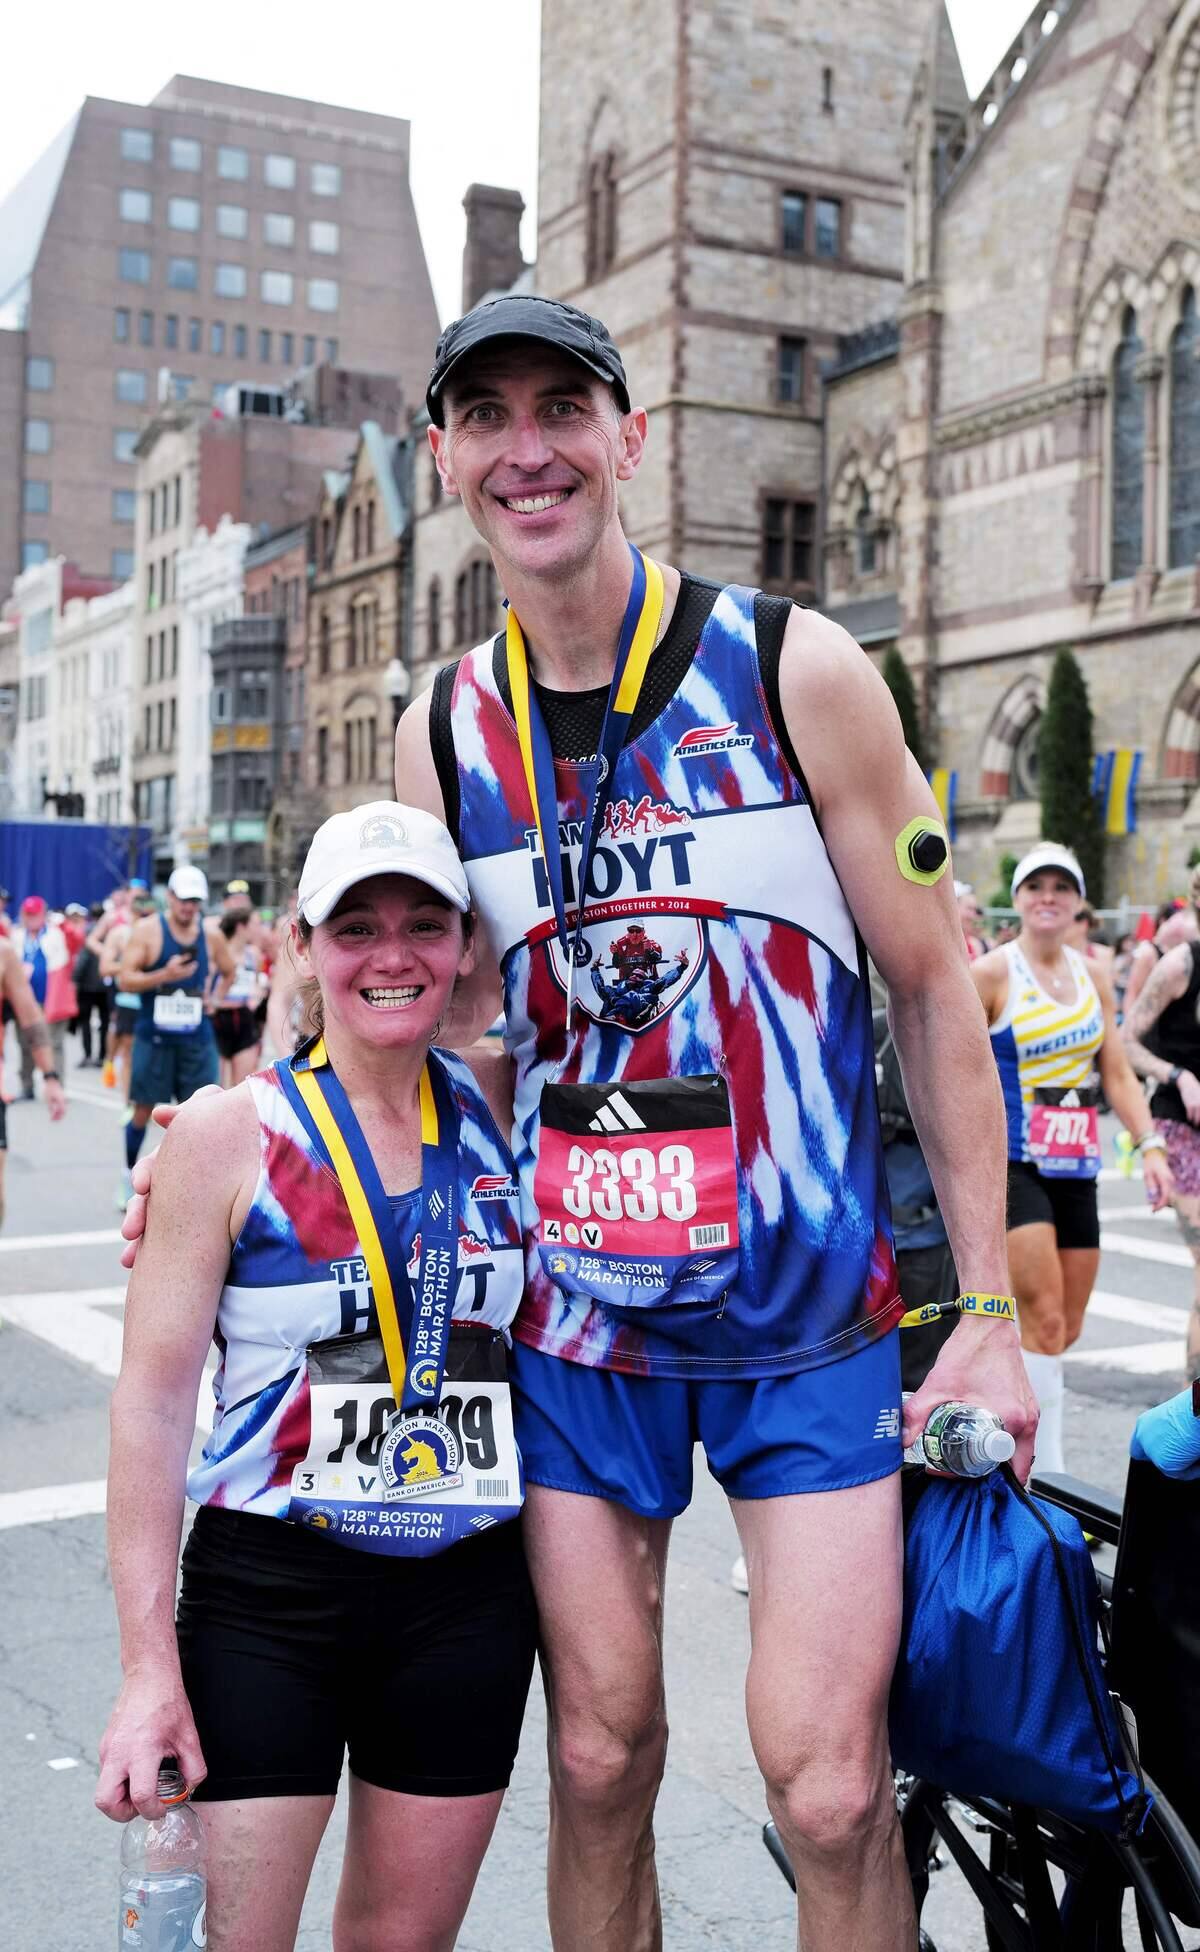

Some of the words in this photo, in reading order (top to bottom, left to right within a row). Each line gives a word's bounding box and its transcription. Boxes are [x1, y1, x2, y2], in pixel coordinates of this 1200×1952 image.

[674, 741, 725, 756] ATHLETICS
[726, 738, 752, 748] EAST
[610, 902, 657, 913] TOGETHER
[1043, 1111, 1090, 1145] 7972
[562, 1145, 697, 1222] 3333
[471, 1189, 506, 1199] ATHLETICS
[507, 1188, 520, 1197] EAS
[547, 1223, 560, 1241] 4
[584, 1228, 598, 1246] V
[579, 1256, 607, 1270] 128TH
[608, 1260, 663, 1276] BOSTON
[420, 1249, 438, 1317] BOSTON
[429, 1251, 451, 1356] MARATHON
[983, 1298, 1011, 1315] VIP
[415, 1319, 430, 1356] 128TH
[387, 1421, 418, 1452] BOSTON
[424, 1421, 456, 1466] MARATHON
[384, 1456, 395, 1482] 128TH
[300, 1473, 314, 1491] 3
[358, 1476, 376, 1494] V
[387, 1490, 405, 1498] BANK
[417, 1481, 446, 1491] AMERICA
[342, 1509, 376, 1522] 128TH
[379, 1511, 443, 1525] BOSTON
